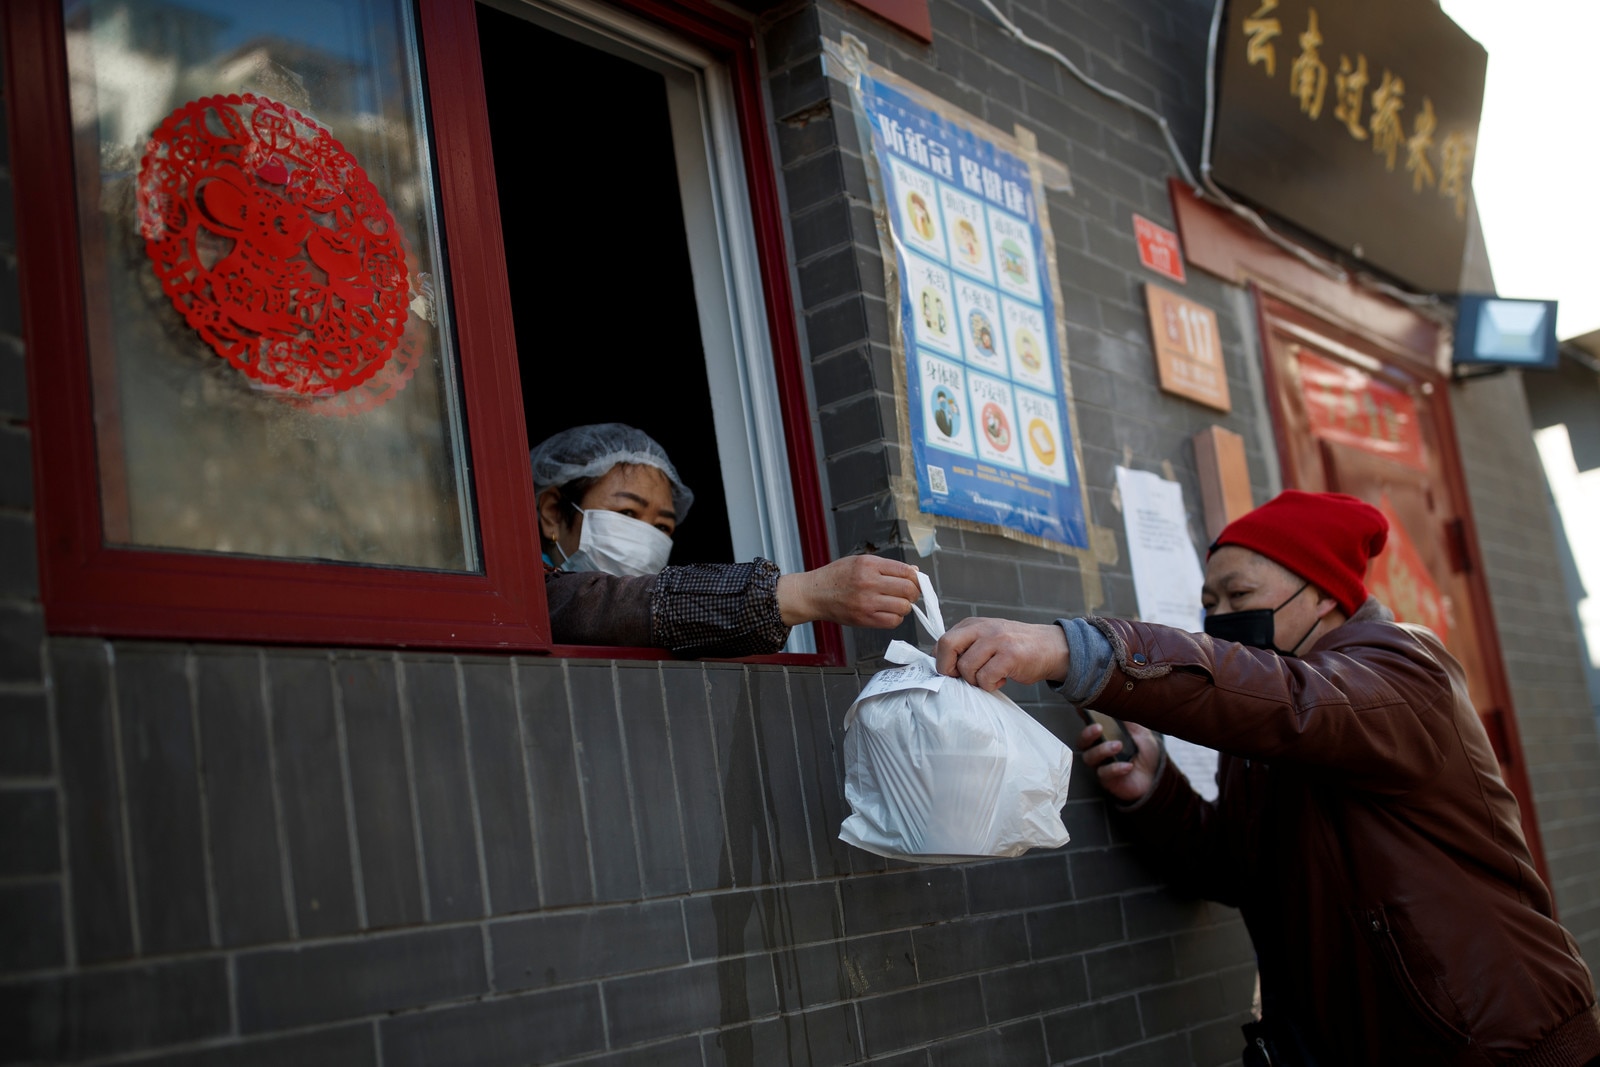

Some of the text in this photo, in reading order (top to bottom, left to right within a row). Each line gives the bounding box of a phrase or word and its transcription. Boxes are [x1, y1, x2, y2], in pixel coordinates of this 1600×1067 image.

[879, 113, 1026, 215] 防新冠 保健康
